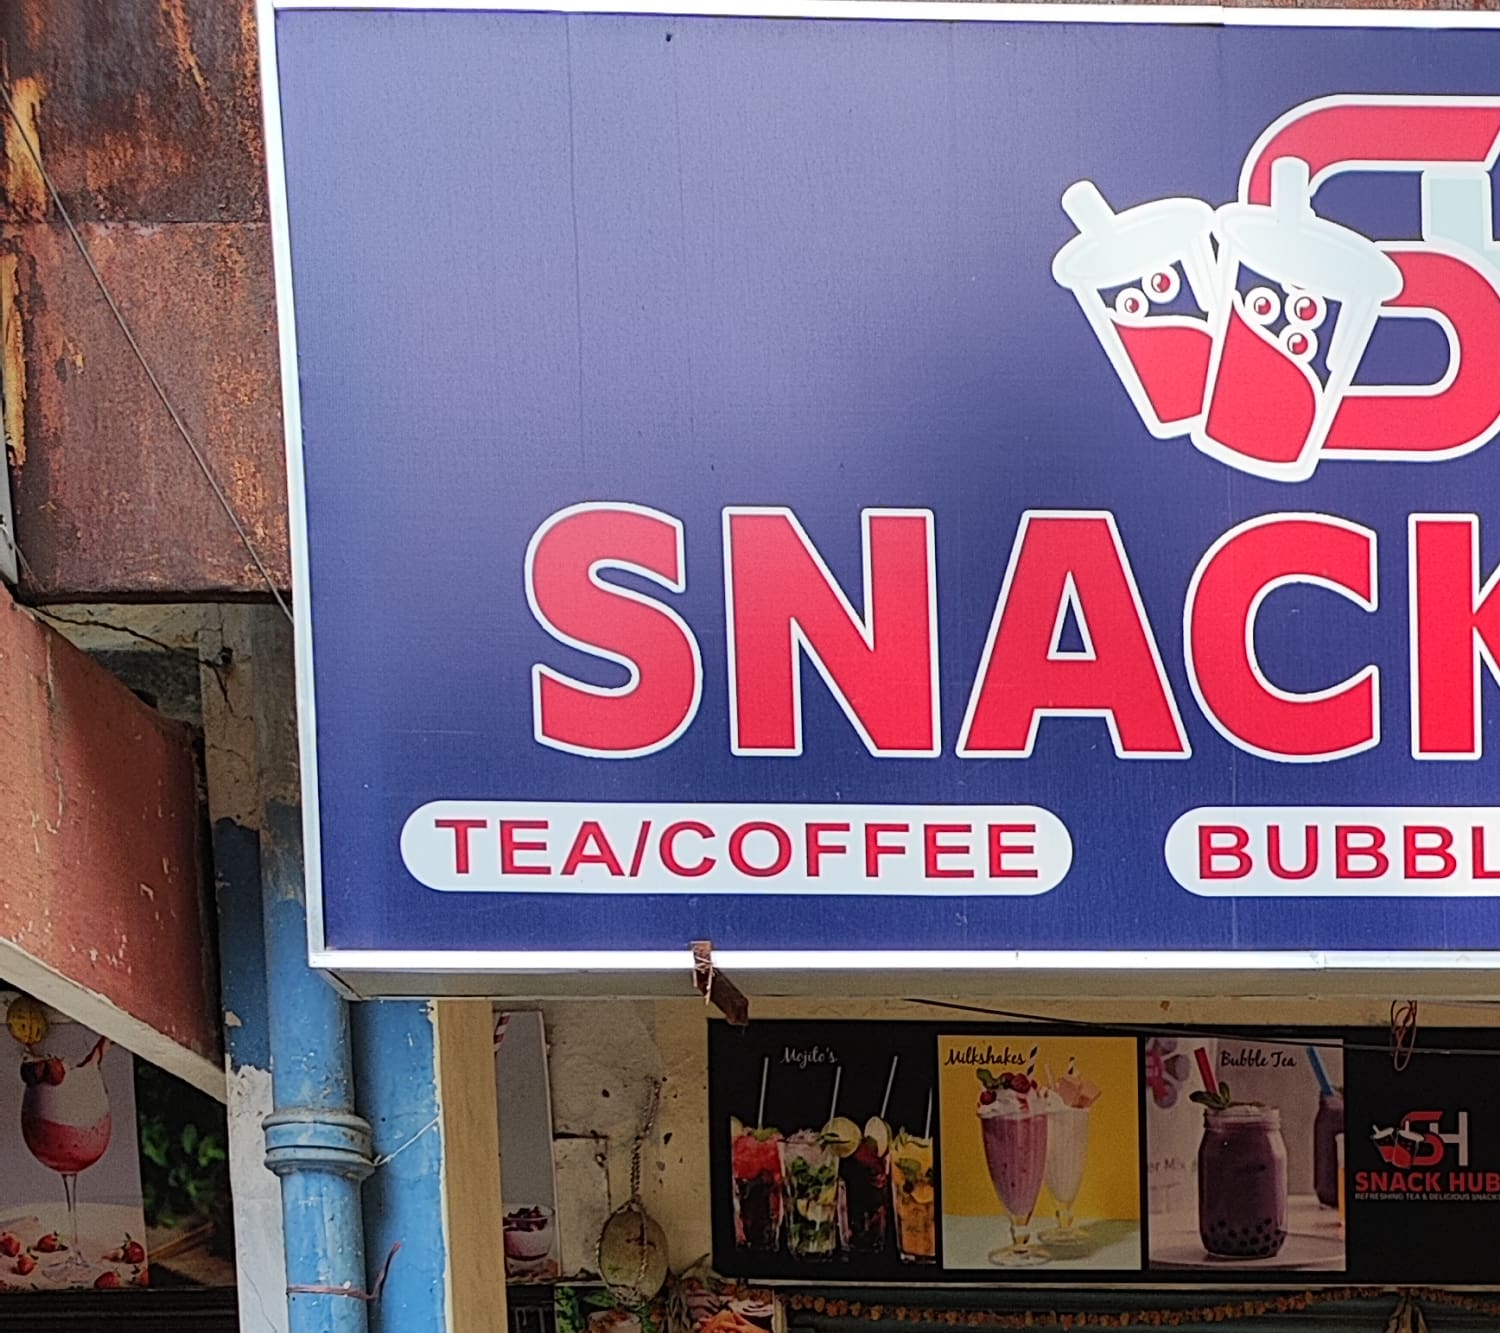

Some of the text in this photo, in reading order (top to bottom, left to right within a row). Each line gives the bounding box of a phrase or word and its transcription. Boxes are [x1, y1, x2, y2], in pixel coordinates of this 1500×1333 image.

[434, 817, 1040, 880] TEA/COFFEE
[780, 1045, 839, 1070] Mojito's
[944, 1045, 1026, 1066] Milkshakes
[1221, 1048, 1297, 1068] Bubble Tea
[1354, 1171, 1442, 1193] SNACK
